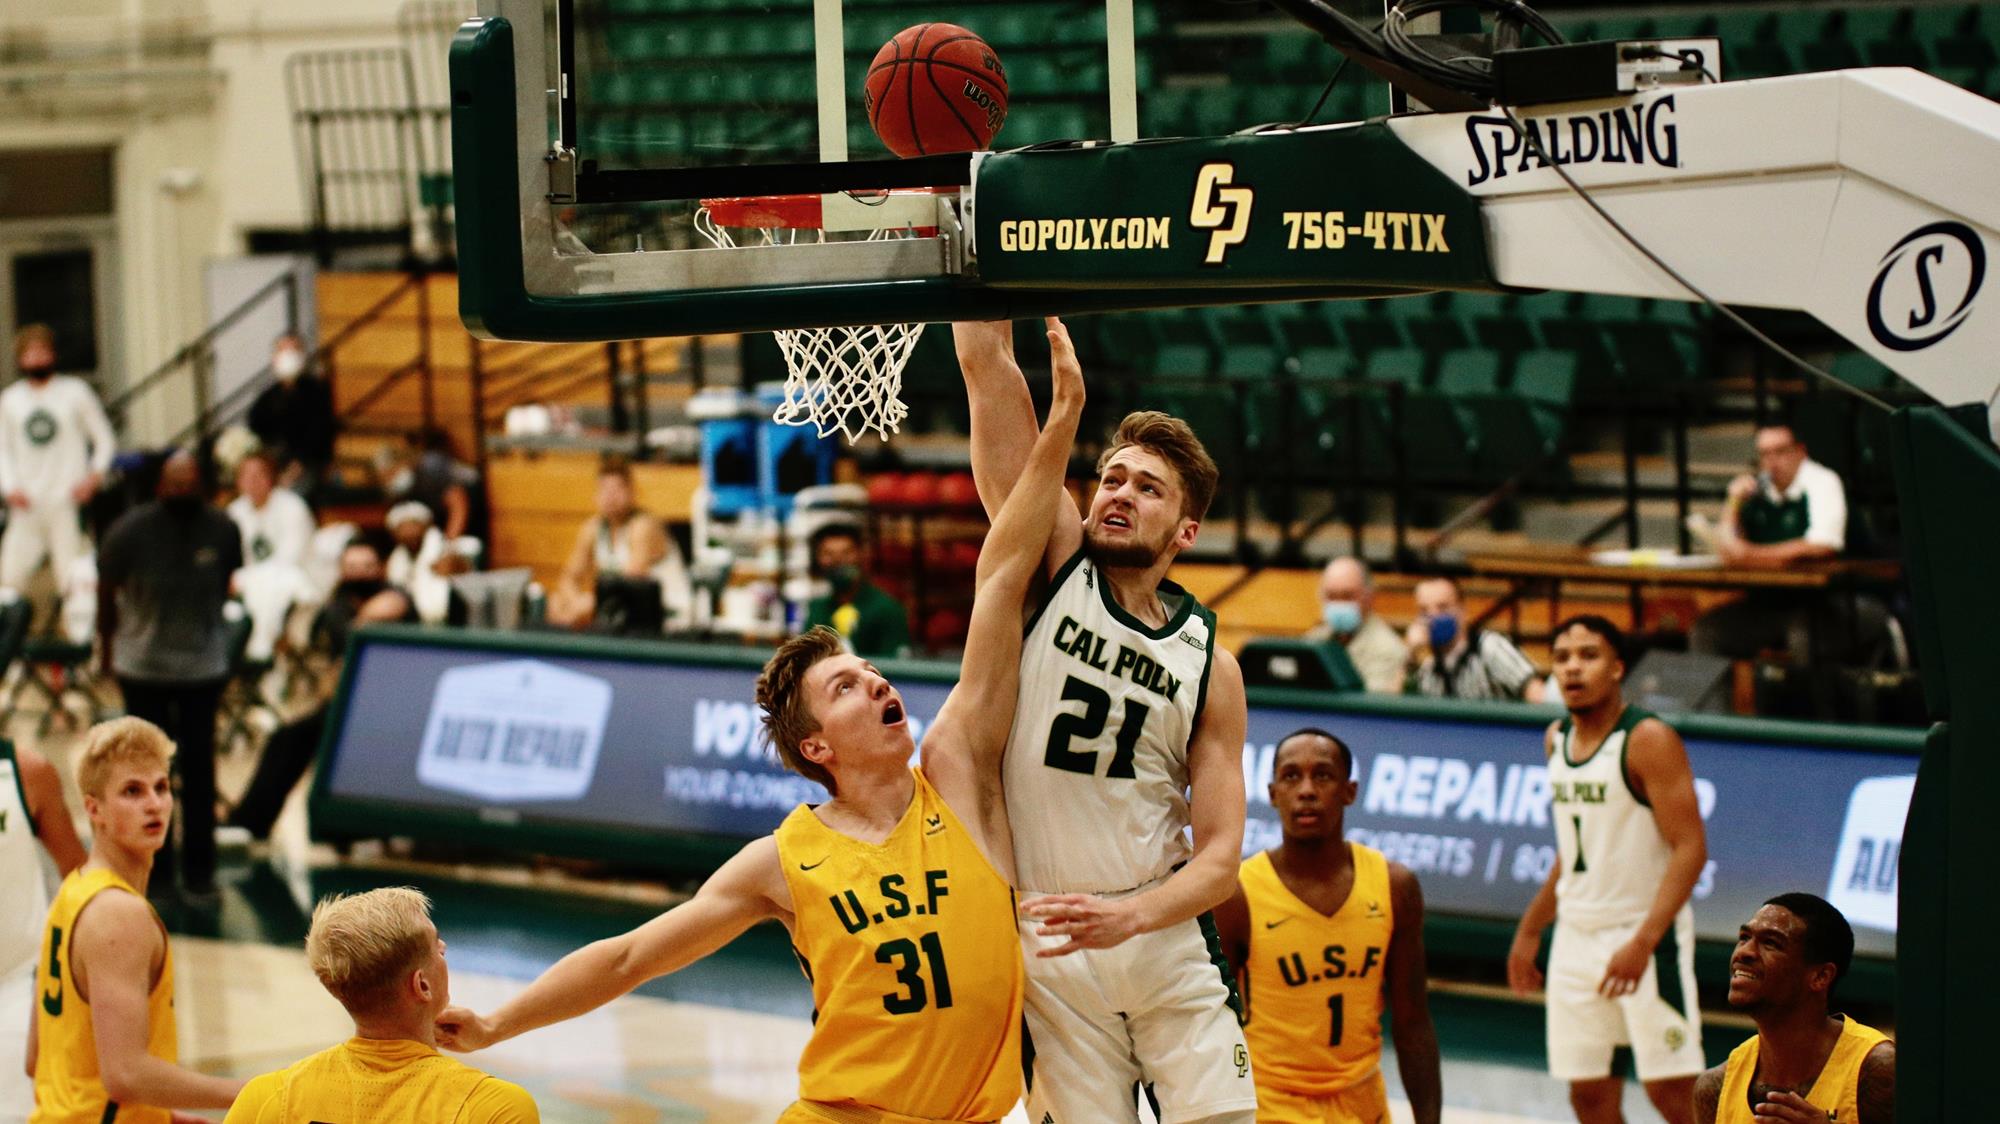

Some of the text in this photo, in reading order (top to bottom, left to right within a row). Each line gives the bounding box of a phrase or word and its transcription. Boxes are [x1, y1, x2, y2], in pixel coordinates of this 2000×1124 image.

[1466, 95, 1678, 186] SPALDING
[1000, 217, 1170, 252] GOPOLY.COM
[1283, 211, 1450, 253] 756-4TIX
[1053, 615, 1182, 702] CAL POLY
[1044, 674, 1150, 779] 21
[1363, 752, 1551, 827] REPAIR
[1573, 782, 1608, 803] POLY
[1572, 814, 1588, 873] 1
[1846, 837, 1900, 894] AU
[829, 869, 949, 935] U.S.F
[874, 931, 953, 1016] 31
[1277, 944, 1381, 988] U.S.F
[1327, 993, 1343, 1048] 1
